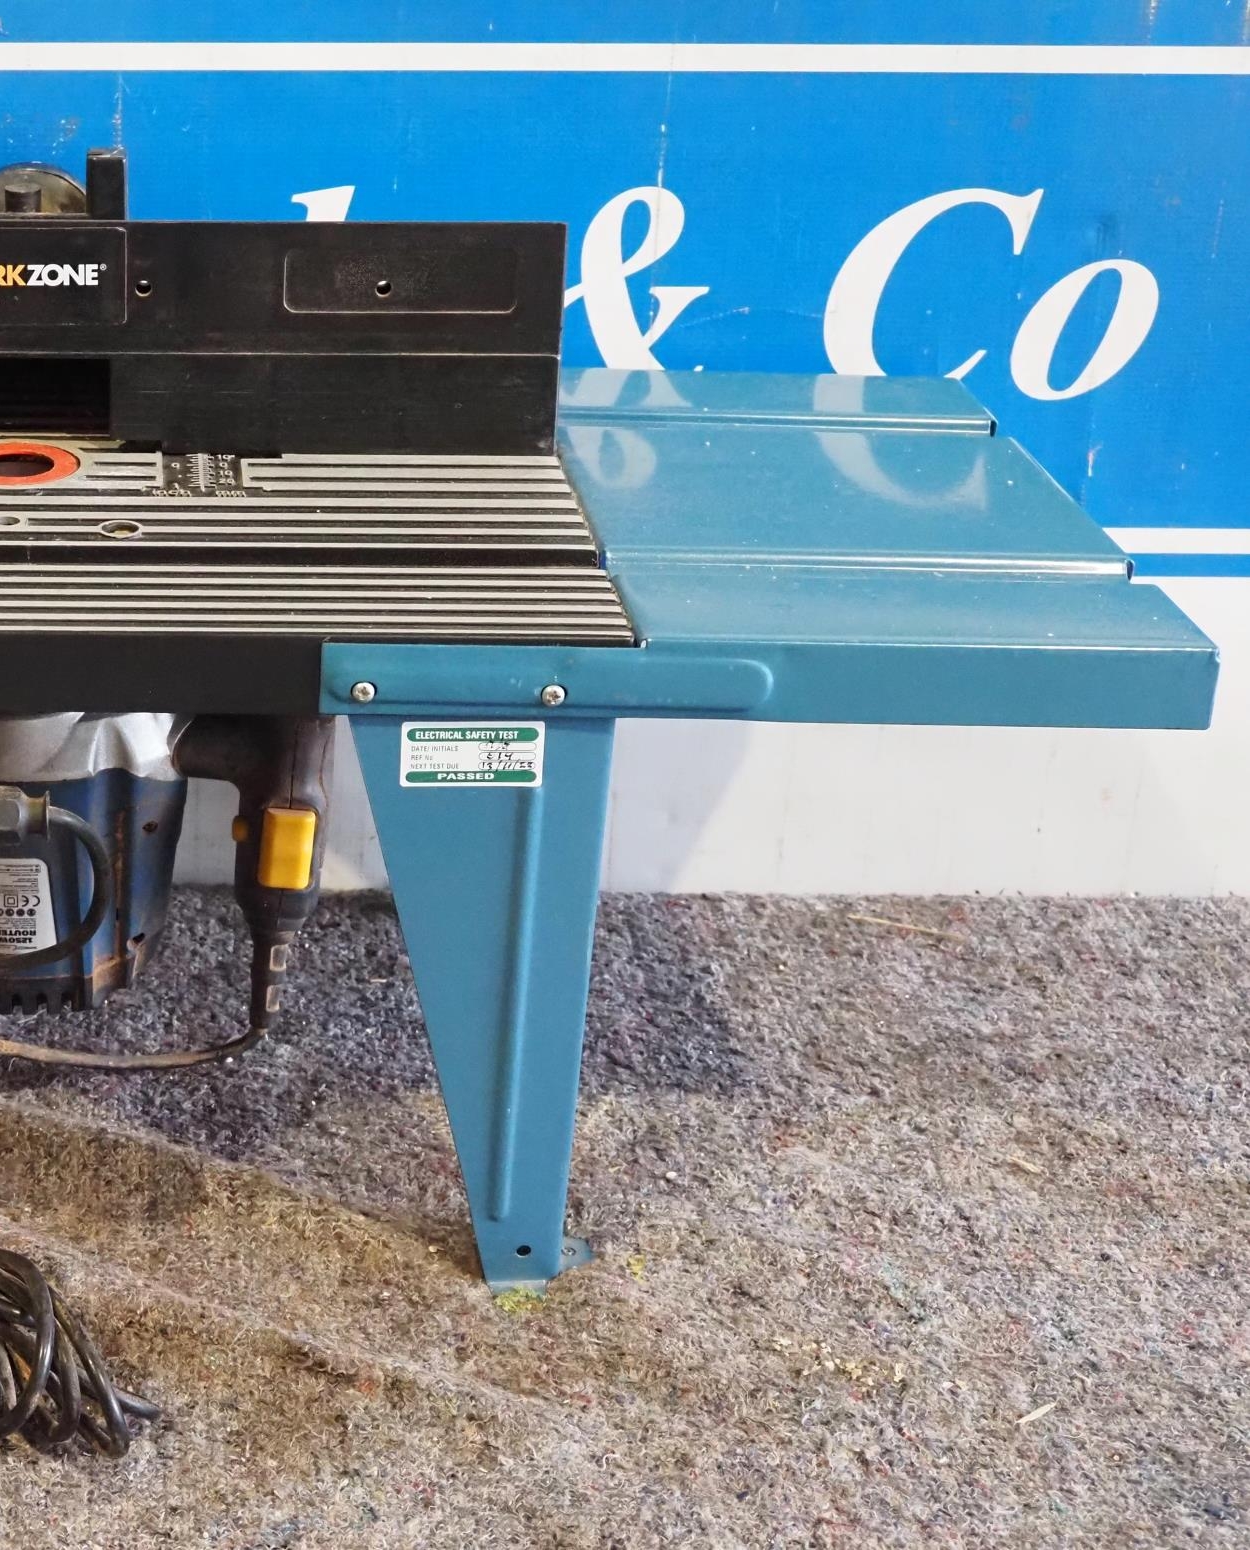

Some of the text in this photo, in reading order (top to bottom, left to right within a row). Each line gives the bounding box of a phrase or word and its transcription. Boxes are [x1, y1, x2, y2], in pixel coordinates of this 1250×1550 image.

[564, 186, 710, 371] &
[823, 188, 1160, 401] Co
[415, 731, 519, 740] ELECTRICAL SAFETY TEST
[437, 772, 495, 780] PASSED
